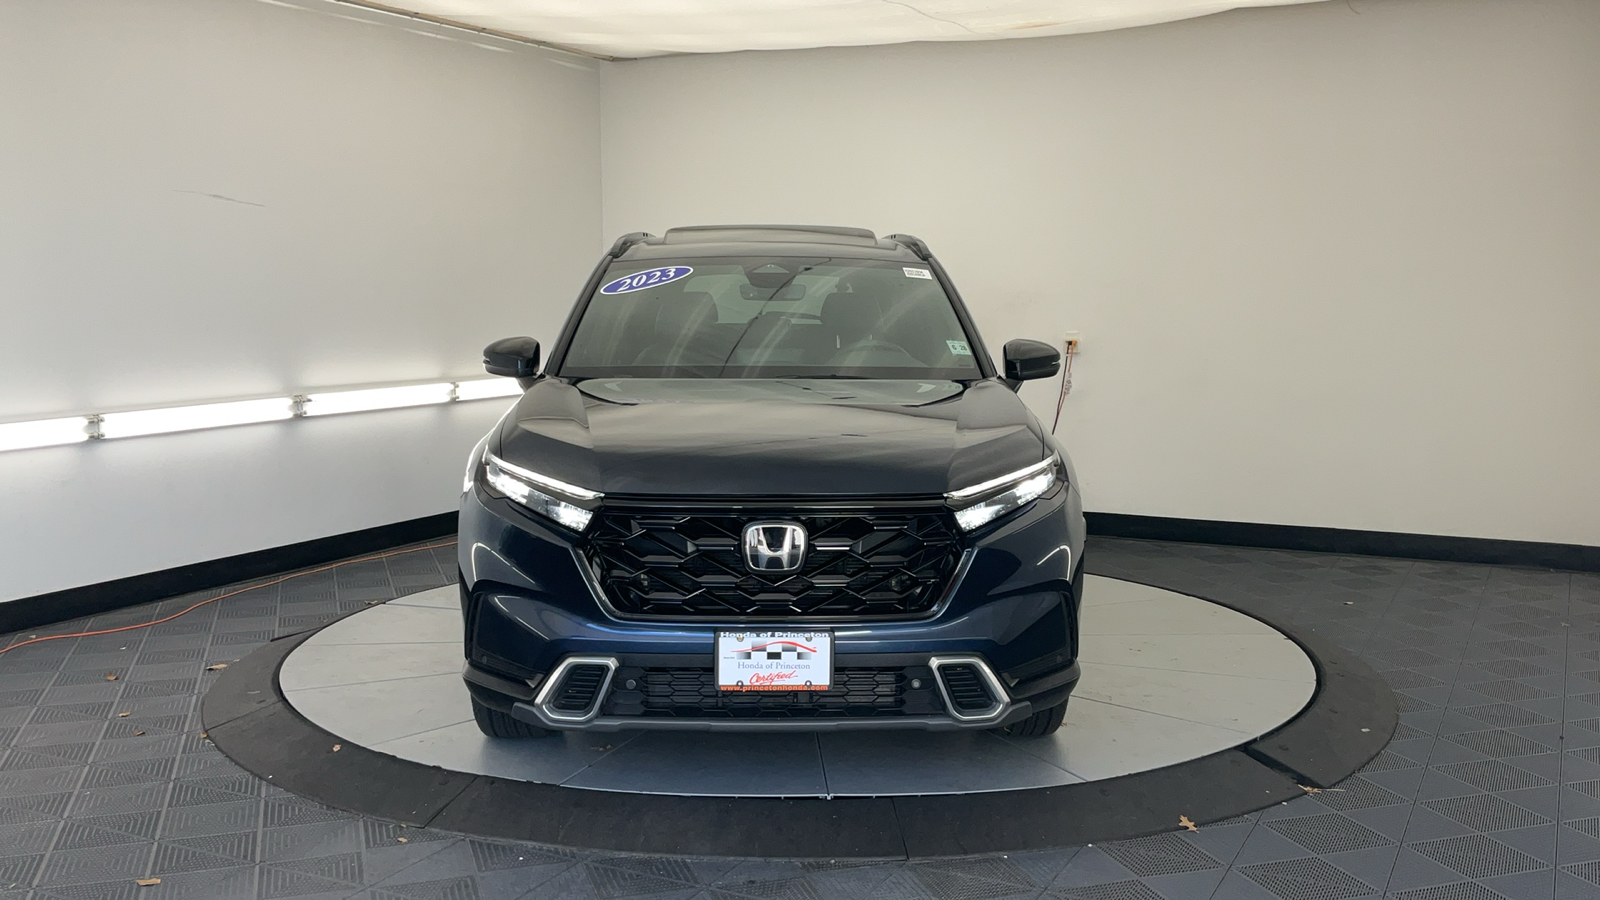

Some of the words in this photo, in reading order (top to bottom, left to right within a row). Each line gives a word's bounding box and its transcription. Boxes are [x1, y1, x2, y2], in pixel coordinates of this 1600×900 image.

[616, 268, 676, 292] 2023
[737, 661, 764, 670] Honda
[765, 661, 775, 670] of
[775, 661, 811, 670] Princeton
[749, 670, 798, 686] Certified
